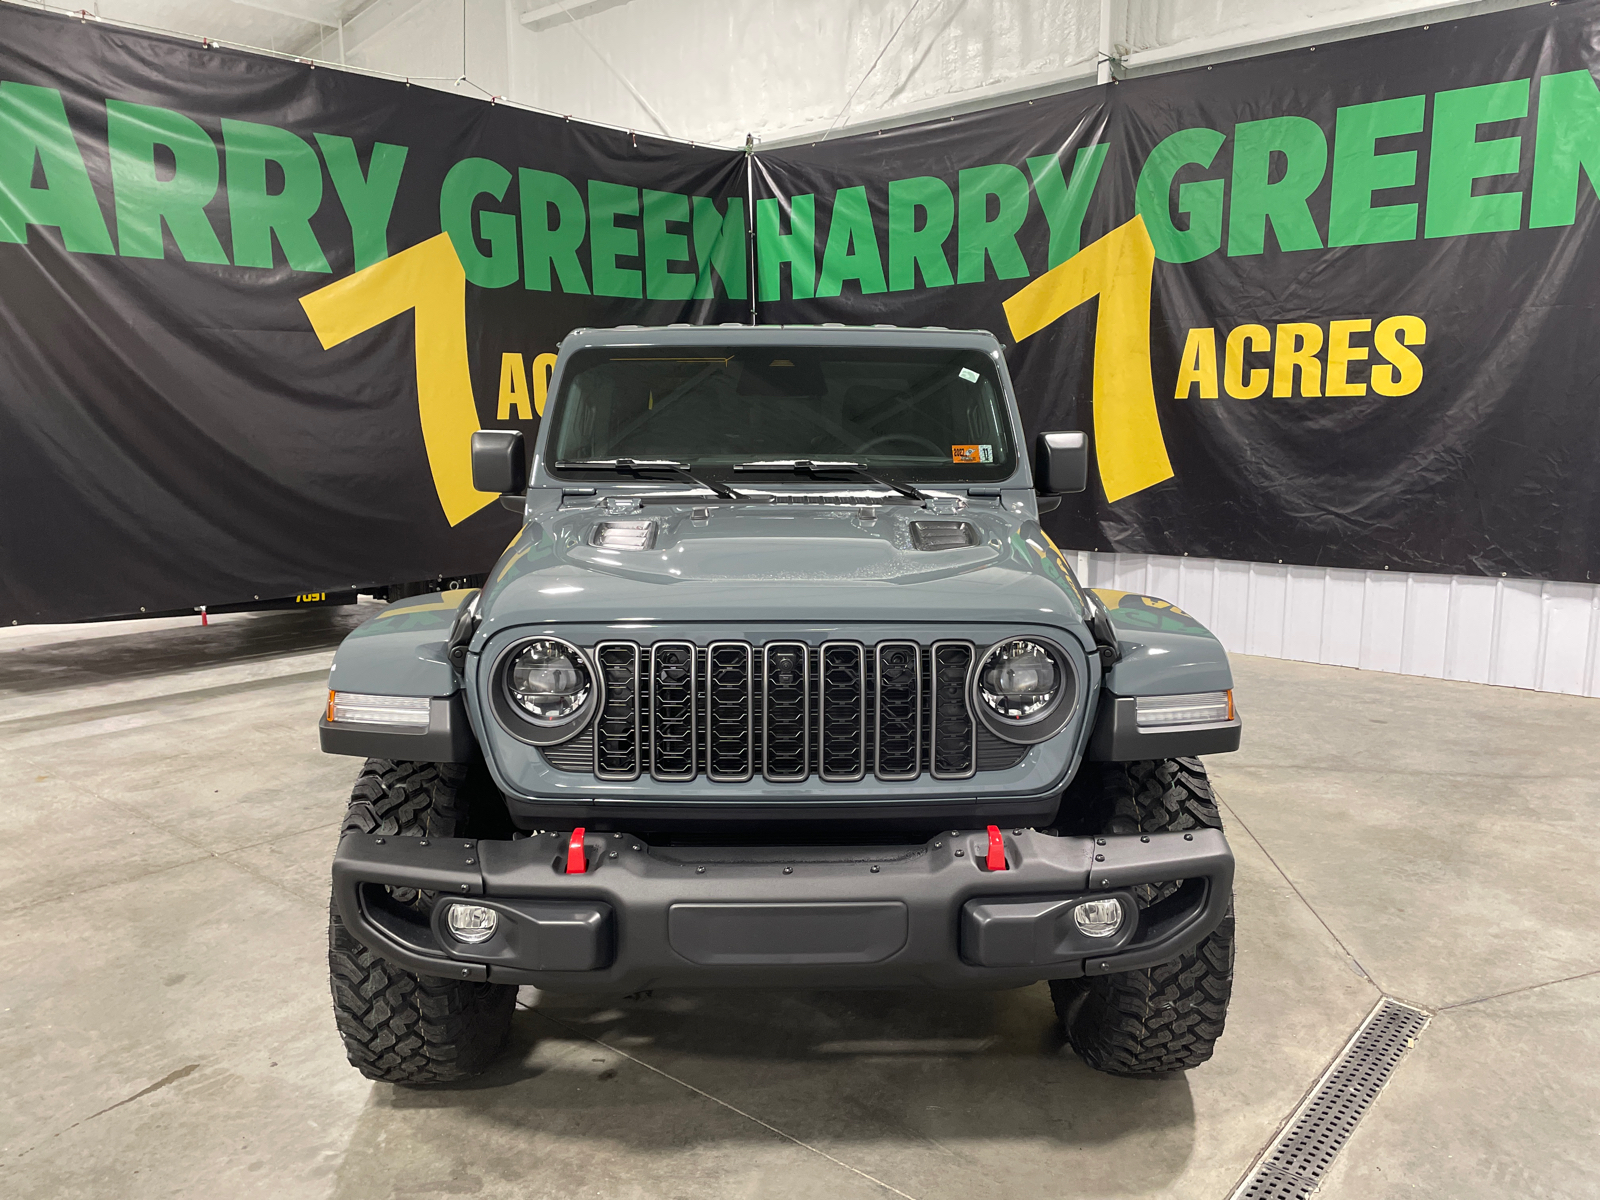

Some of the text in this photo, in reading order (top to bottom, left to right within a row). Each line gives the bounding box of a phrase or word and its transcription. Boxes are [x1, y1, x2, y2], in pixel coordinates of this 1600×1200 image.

[439, 157, 748, 301] GREEN
[756, 68, 1600, 302] HARRY GREEN
[299, 231, 502, 527] 7
[1002, 213, 1427, 504] 7 ACRES
